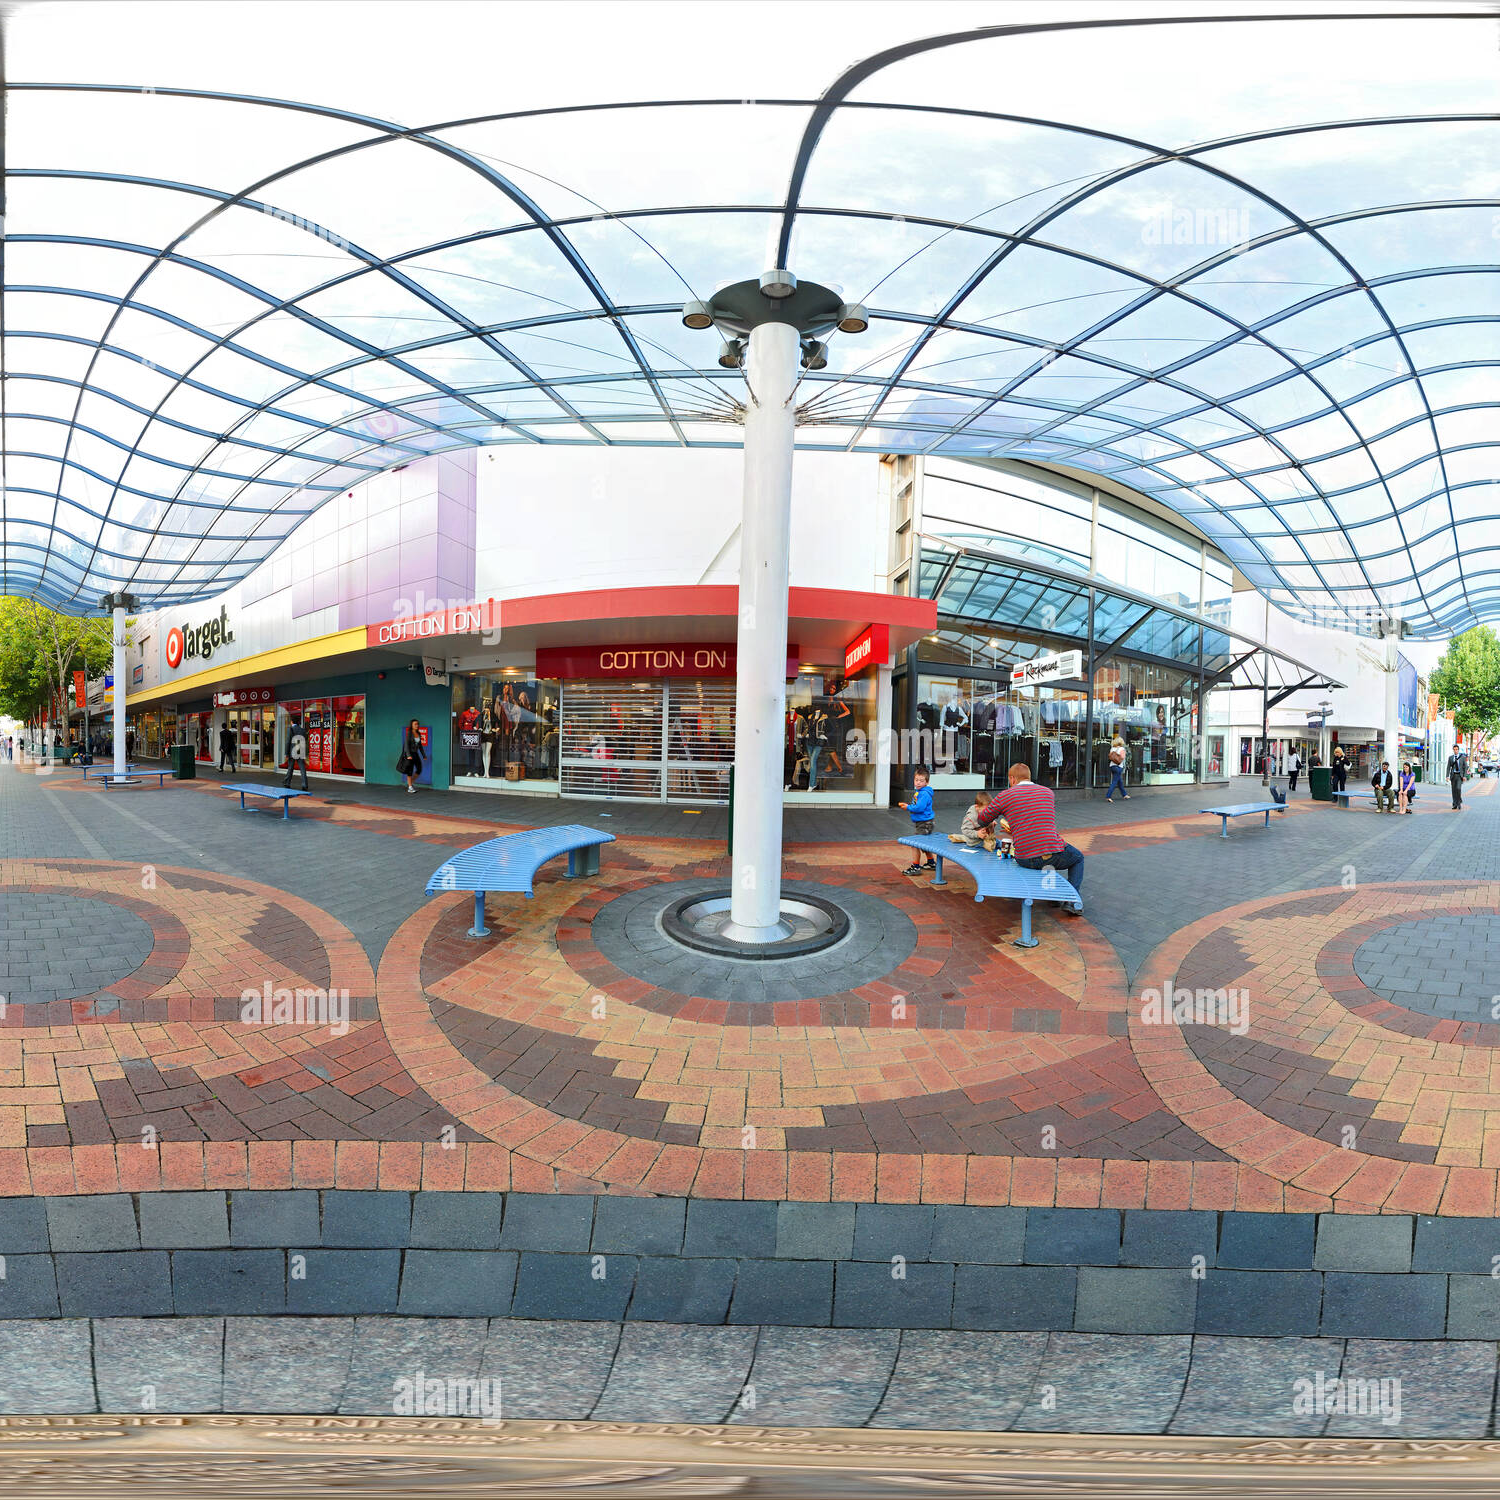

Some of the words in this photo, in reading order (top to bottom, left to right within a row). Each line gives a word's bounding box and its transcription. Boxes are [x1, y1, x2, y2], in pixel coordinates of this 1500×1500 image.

[379, 616, 445, 643] COTTON
[453, 609, 481, 631] ON
[600, 650, 684, 669] COTTON
[694, 650, 726, 669] ON
[310, 733, 320, 744] 20
